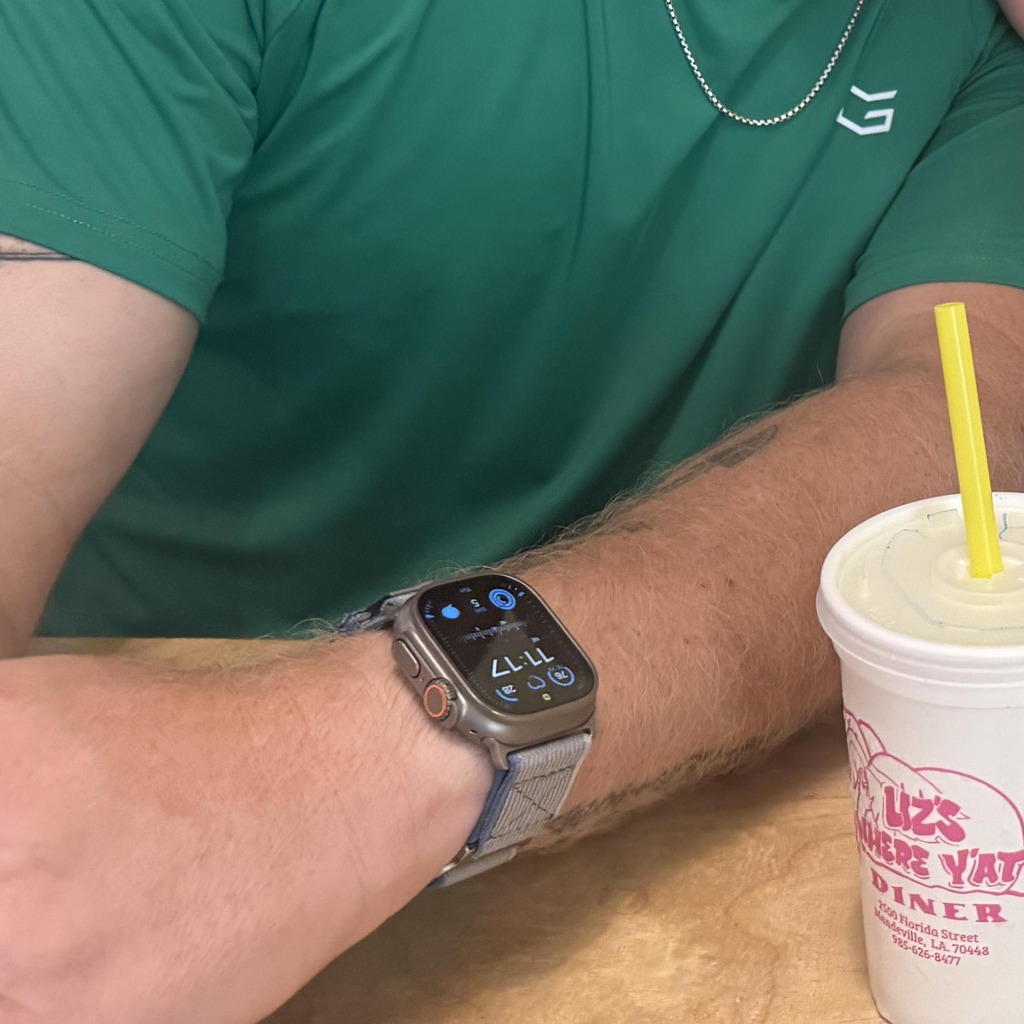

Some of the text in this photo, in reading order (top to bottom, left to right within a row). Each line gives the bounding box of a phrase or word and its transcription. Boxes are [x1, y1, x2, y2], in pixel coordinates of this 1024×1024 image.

[491, 647, 555, 678] 11:17
[884, 786, 966, 843] LIZ'S
[870, 866, 1008, 924] DINER
[878, 899, 979, 943] 2500 Florida Street
[892, 934, 962, 966] 985-626-8477
[952, 943, 990, 956] 70448
